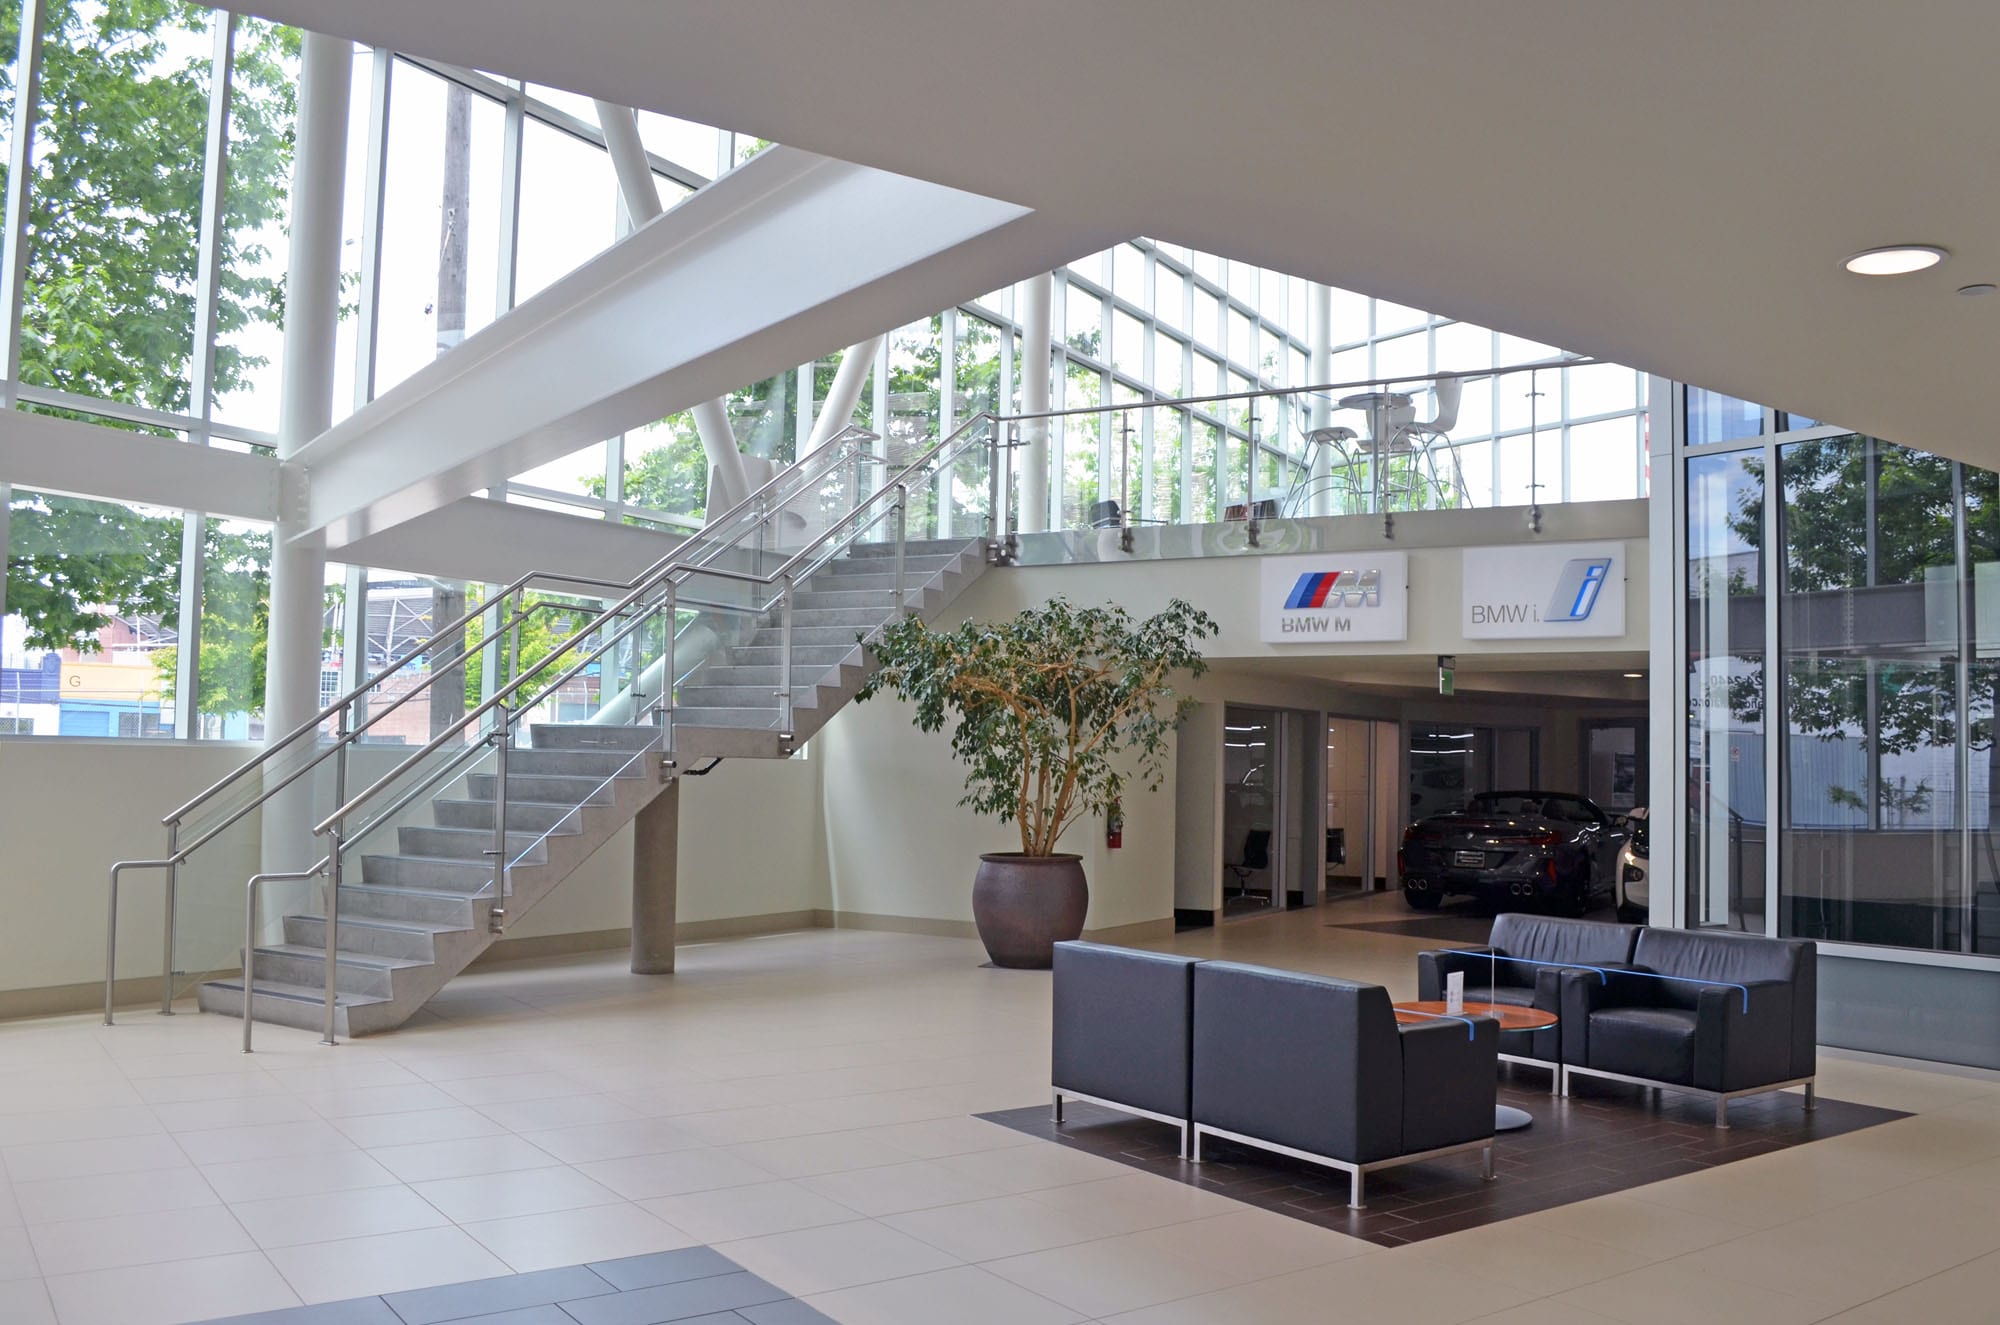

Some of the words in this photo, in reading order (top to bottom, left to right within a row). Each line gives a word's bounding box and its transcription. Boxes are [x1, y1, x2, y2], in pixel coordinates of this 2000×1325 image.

[1471, 604, 1527, 624] BMW
[1281, 616, 1329, 633] BMW
[1335, 616, 1351, 632] M
[69, 675, 81, 688] G
